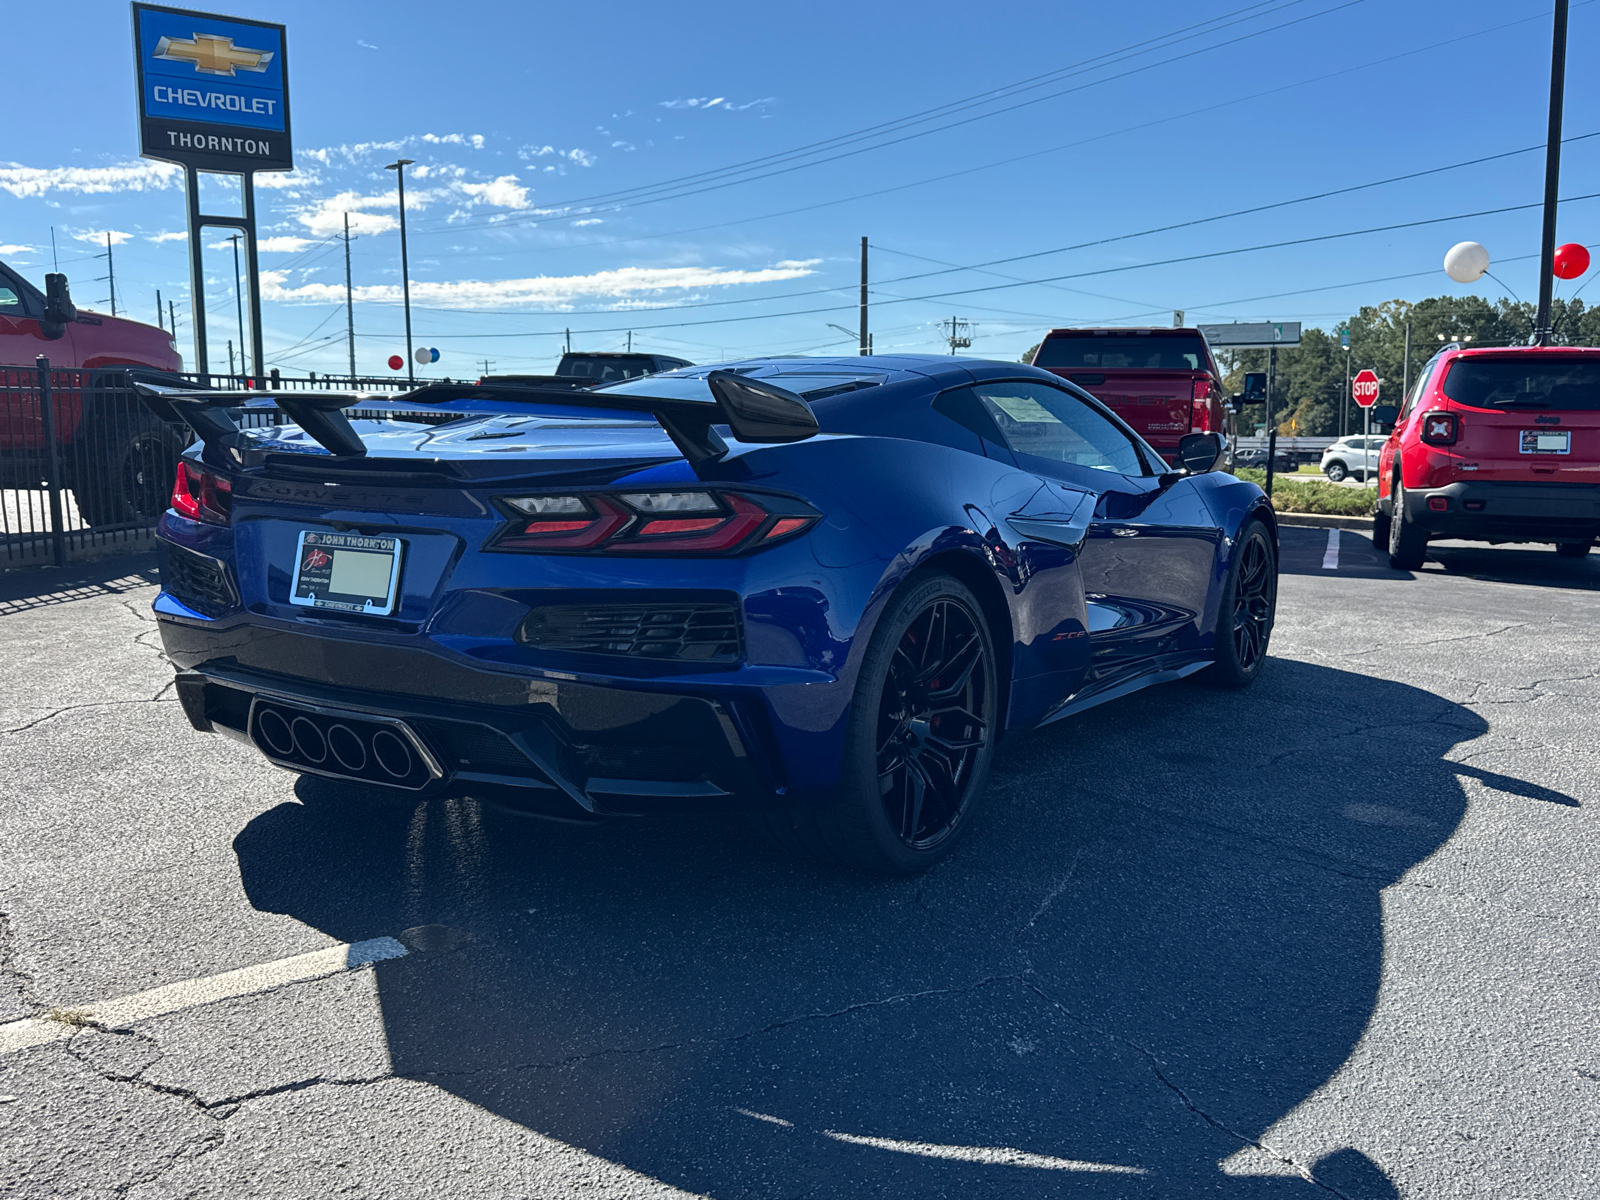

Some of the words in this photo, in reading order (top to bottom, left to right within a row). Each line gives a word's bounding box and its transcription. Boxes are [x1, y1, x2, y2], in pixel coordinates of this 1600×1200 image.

[153, 85, 276, 116] CHEVROLET
[167, 131, 270, 156] THORNTON
[1354, 381, 1377, 396] STOP
[257, 483, 429, 504] CORVETTE
[321, 534, 344, 546] JOHN
[346, 536, 395, 550] THORNTON
[324, 602, 354, 611] CHEVROLET
